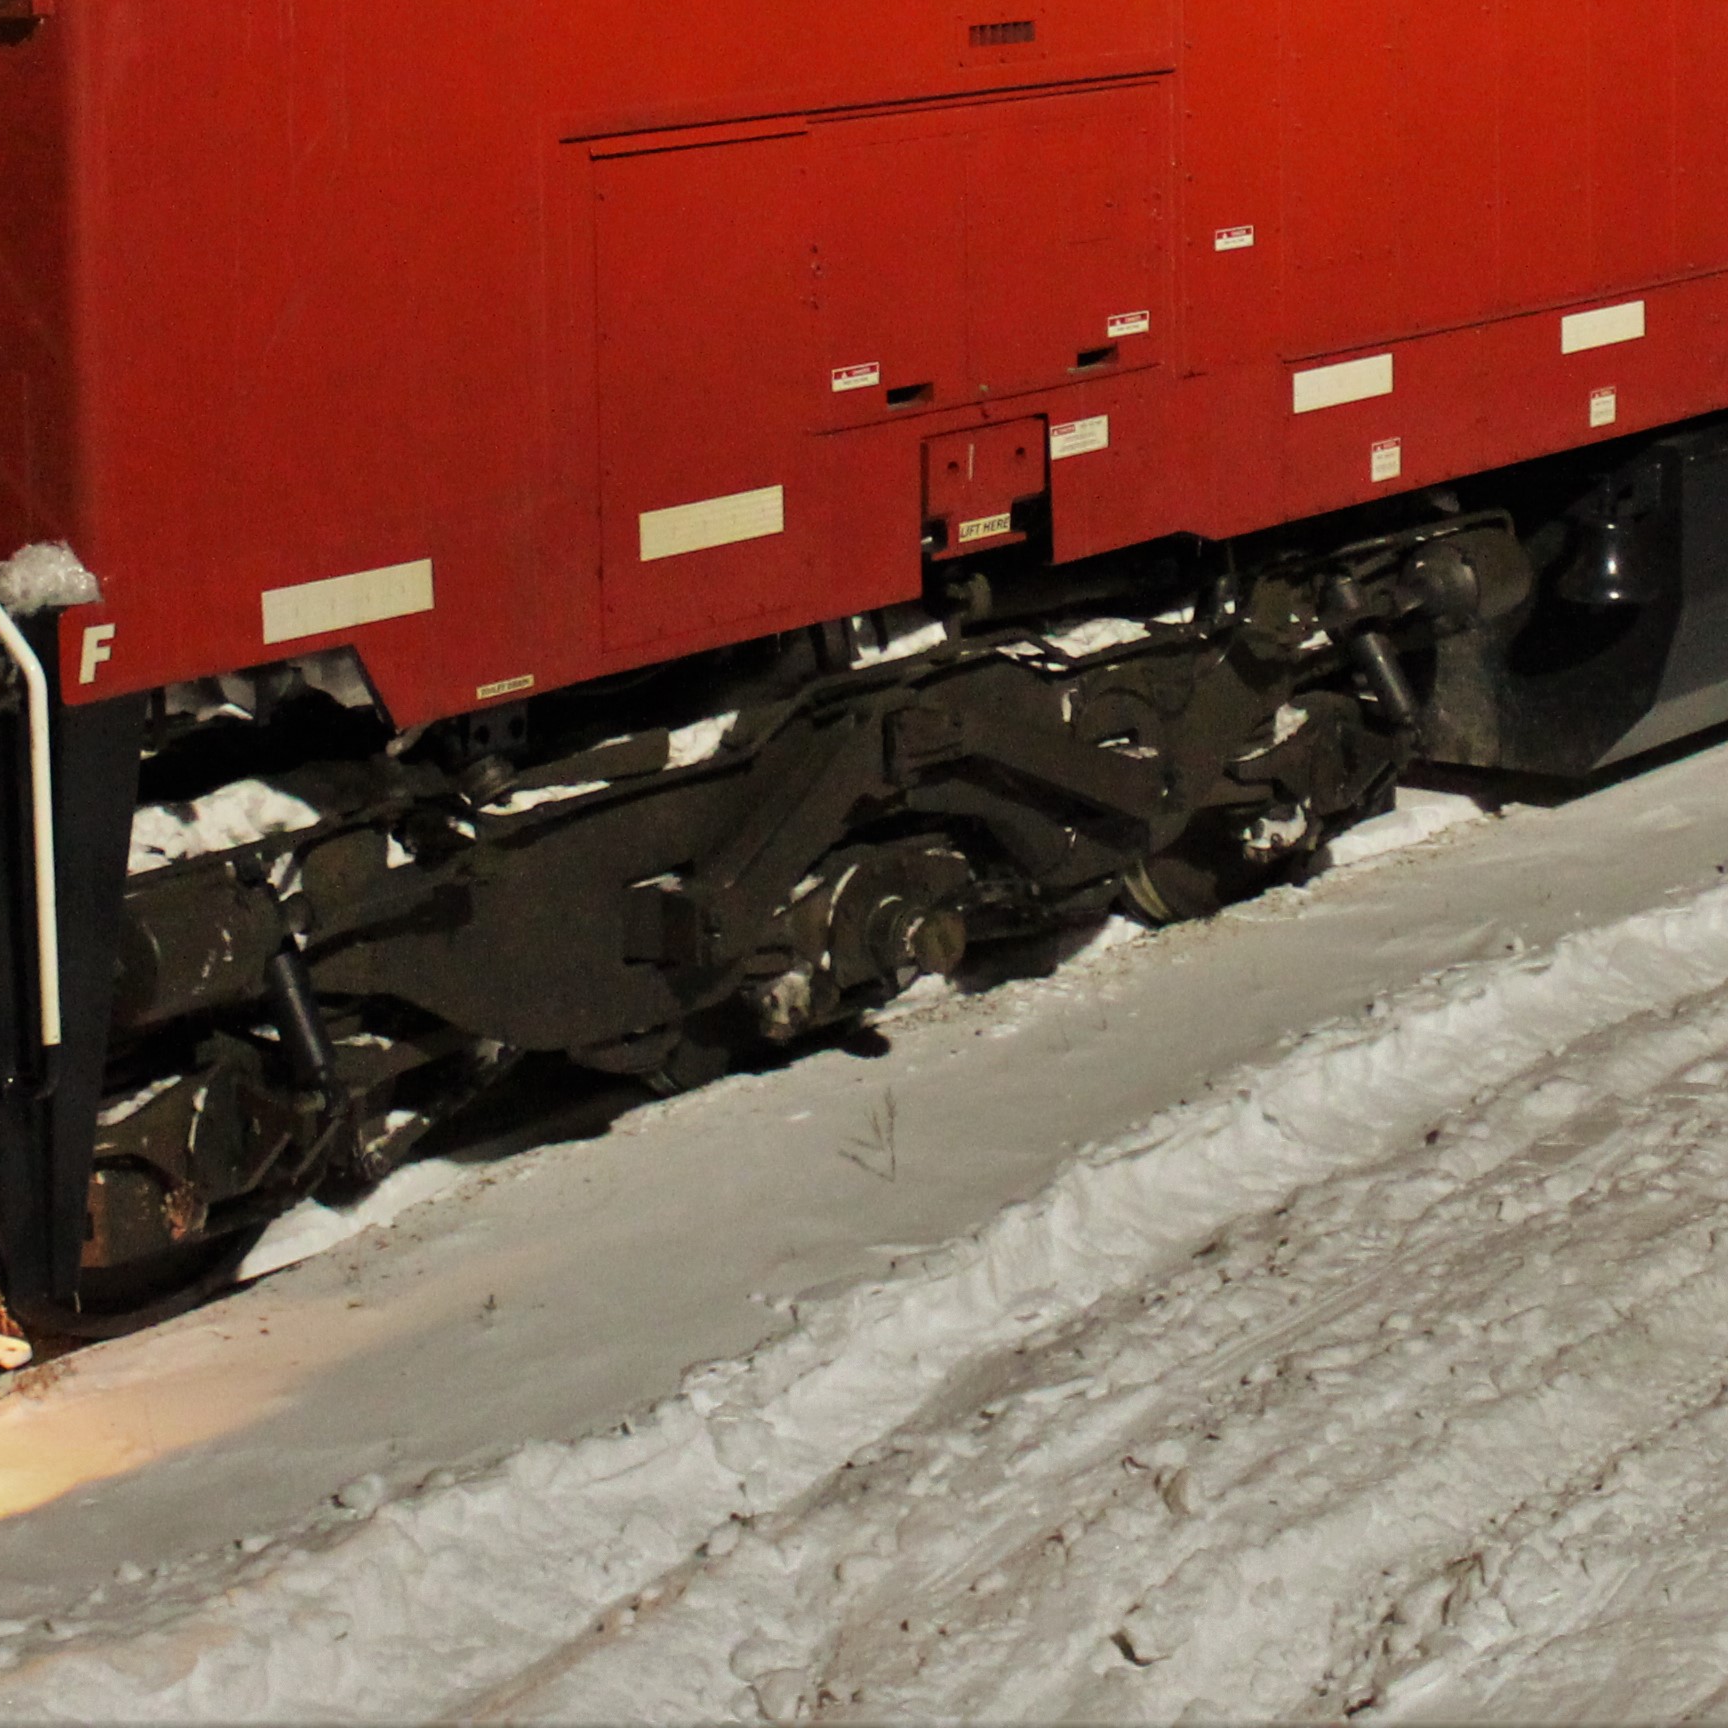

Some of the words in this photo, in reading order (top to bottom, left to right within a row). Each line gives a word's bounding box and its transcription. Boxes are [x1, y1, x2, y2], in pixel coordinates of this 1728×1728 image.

[959, 522, 981, 539] LIFT
[983, 516, 1010, 534] HERE
[78, 622, 116, 685] F
